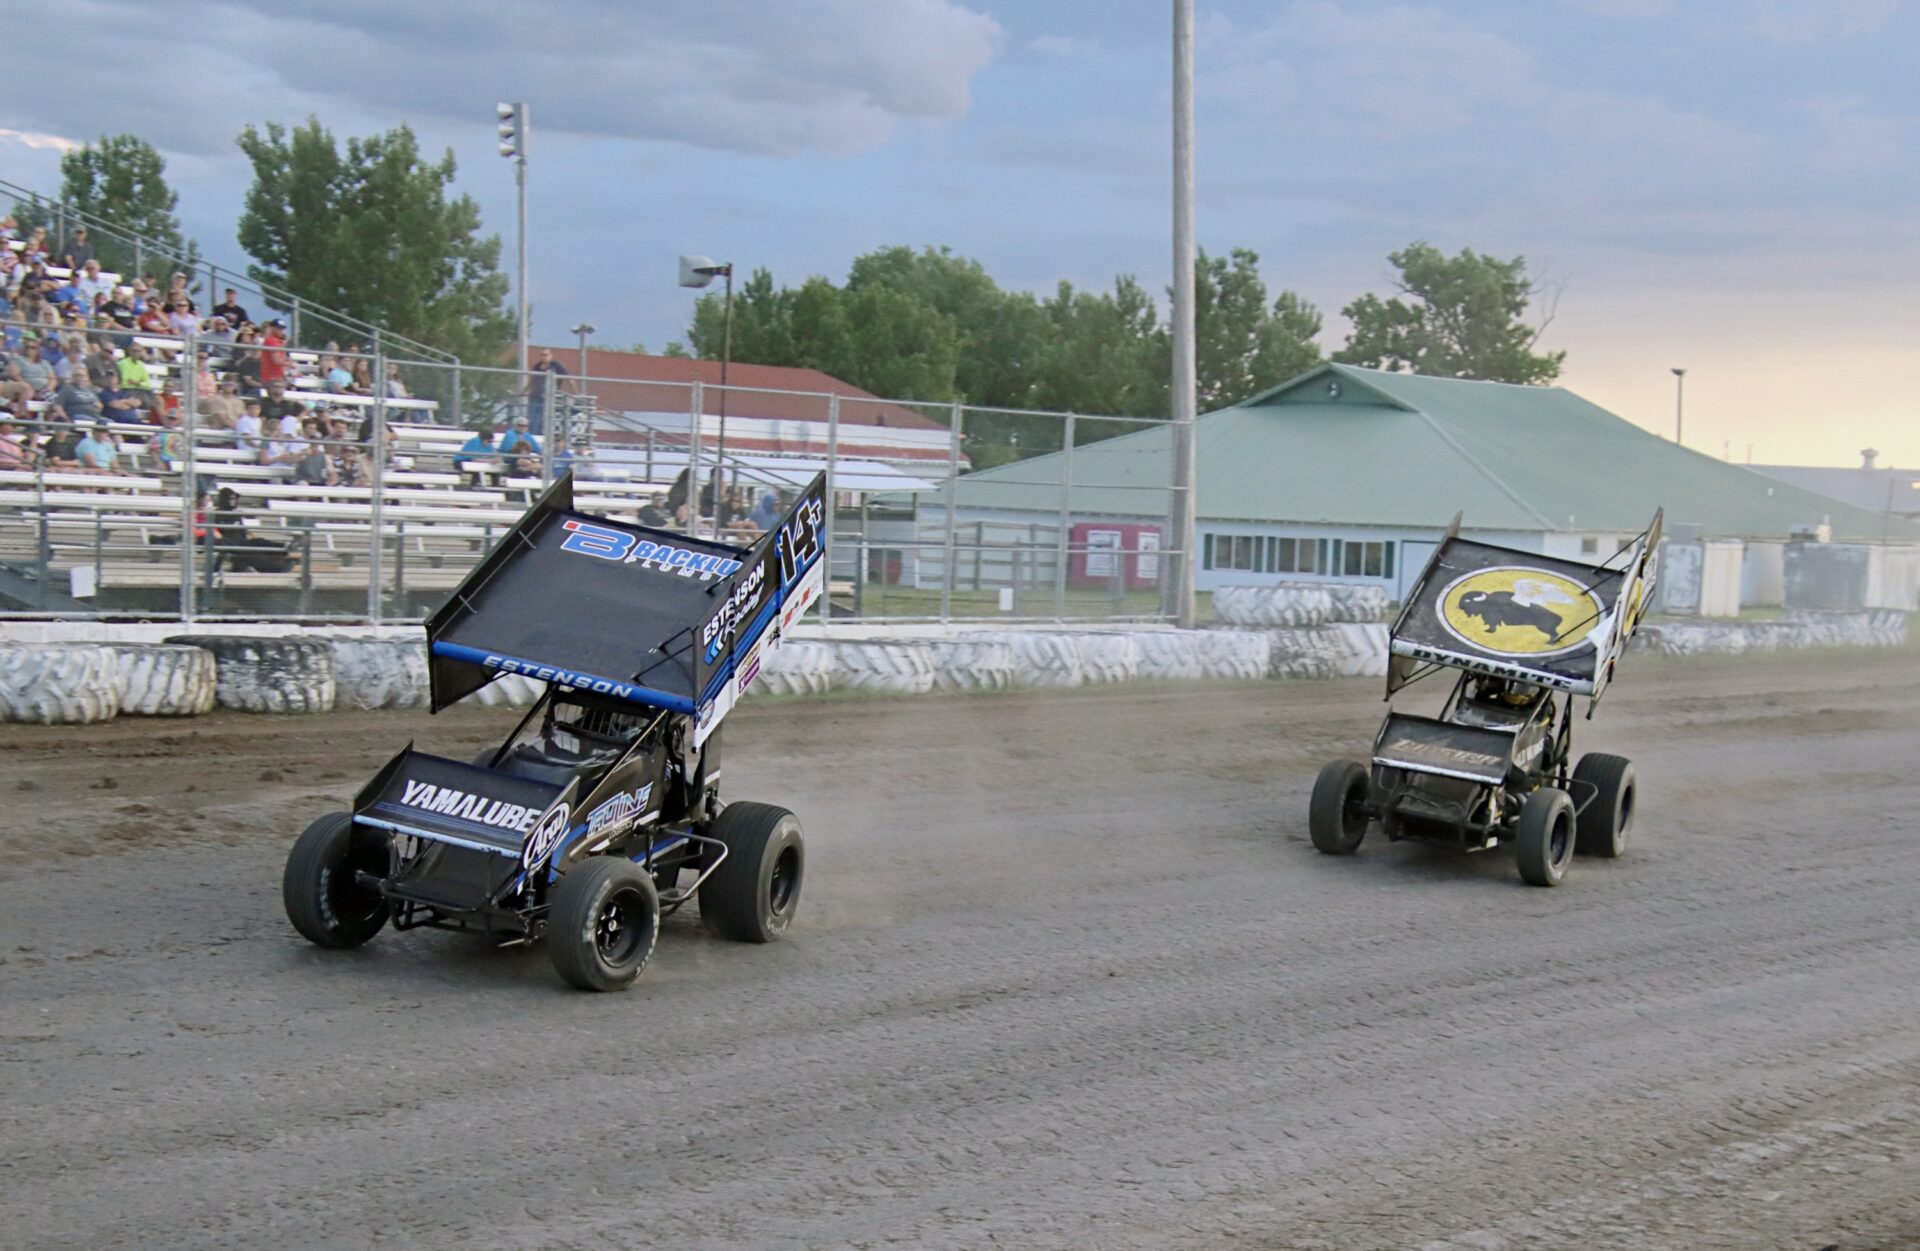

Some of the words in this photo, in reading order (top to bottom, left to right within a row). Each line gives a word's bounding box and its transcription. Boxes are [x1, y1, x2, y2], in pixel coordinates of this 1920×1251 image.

[703, 559, 765, 646] ESTENSON
[482, 655, 634, 698] ESTENSON
[1412, 648, 1573, 689] DYNAMITE
[400, 779, 542, 833] YAMALUBE
